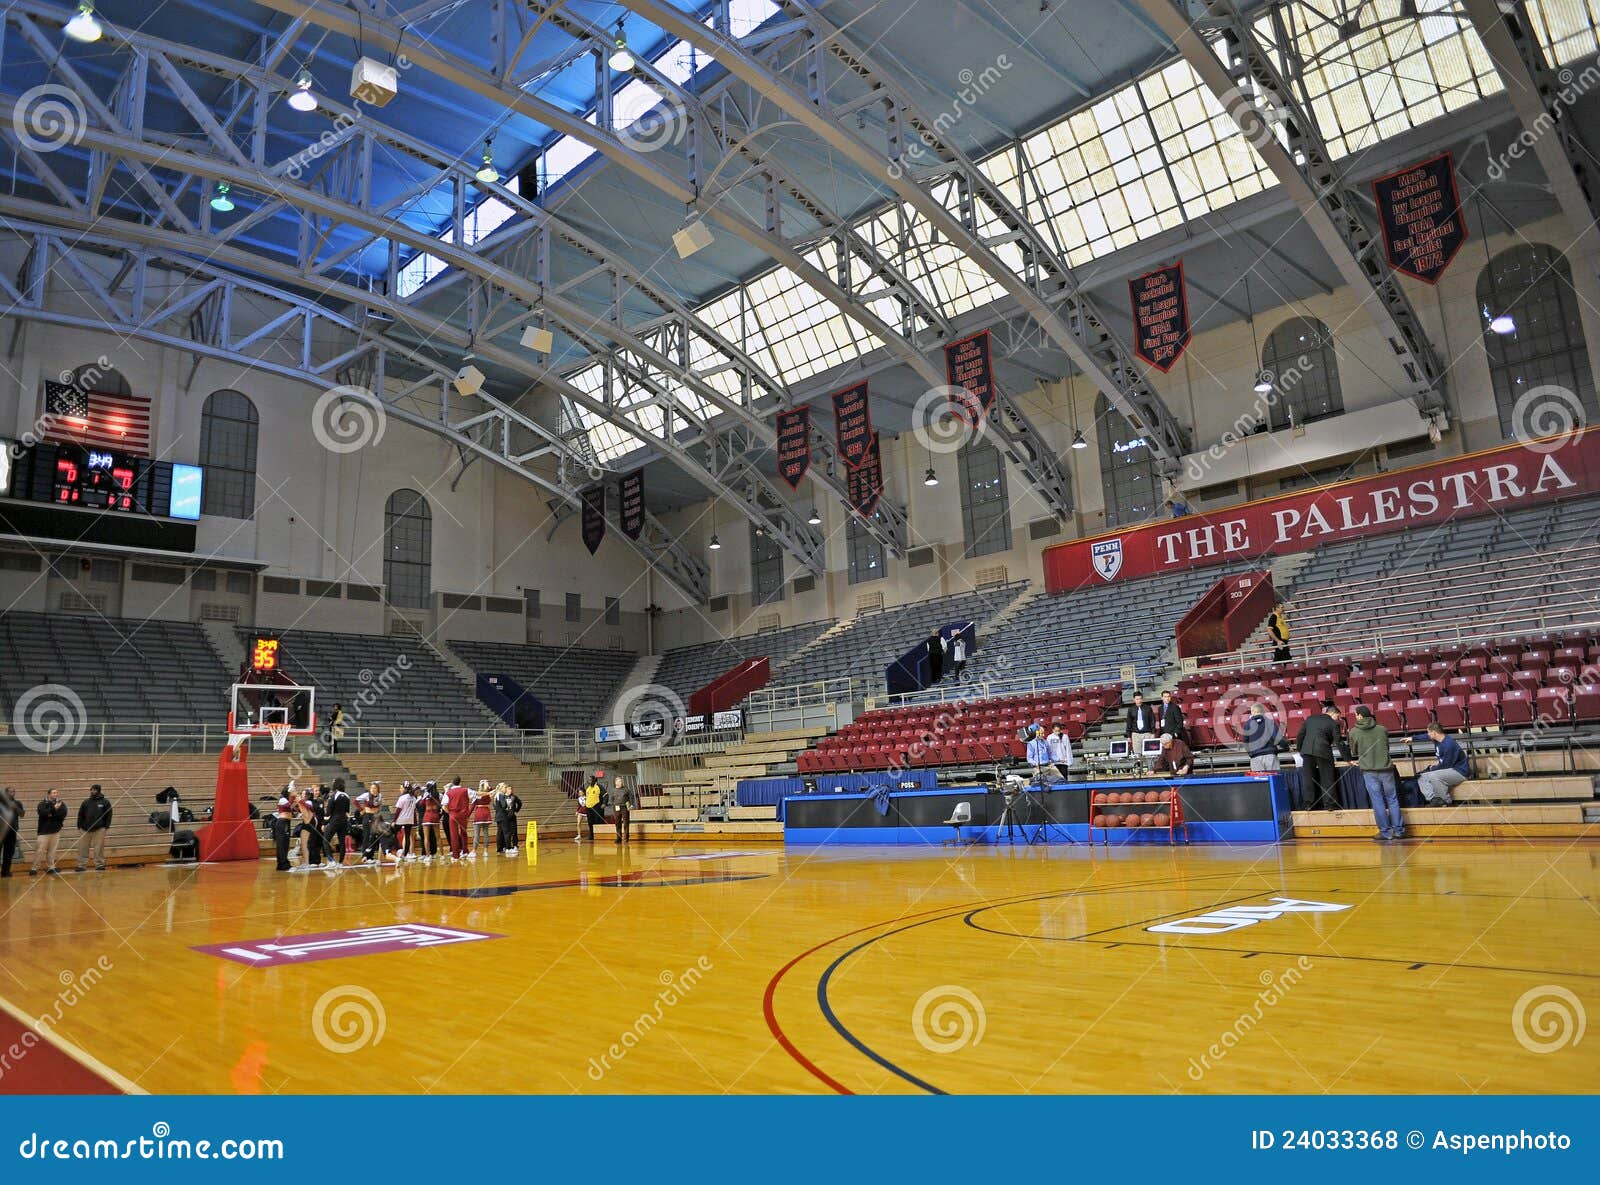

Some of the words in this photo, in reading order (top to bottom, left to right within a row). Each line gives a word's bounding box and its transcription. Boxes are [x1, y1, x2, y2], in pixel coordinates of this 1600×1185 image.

[1157, 517, 1251, 565] THE
[1271, 453, 1577, 544] PALESTRA
[1094, 542, 1119, 554] PENN
[254, 649, 275, 670] 35
